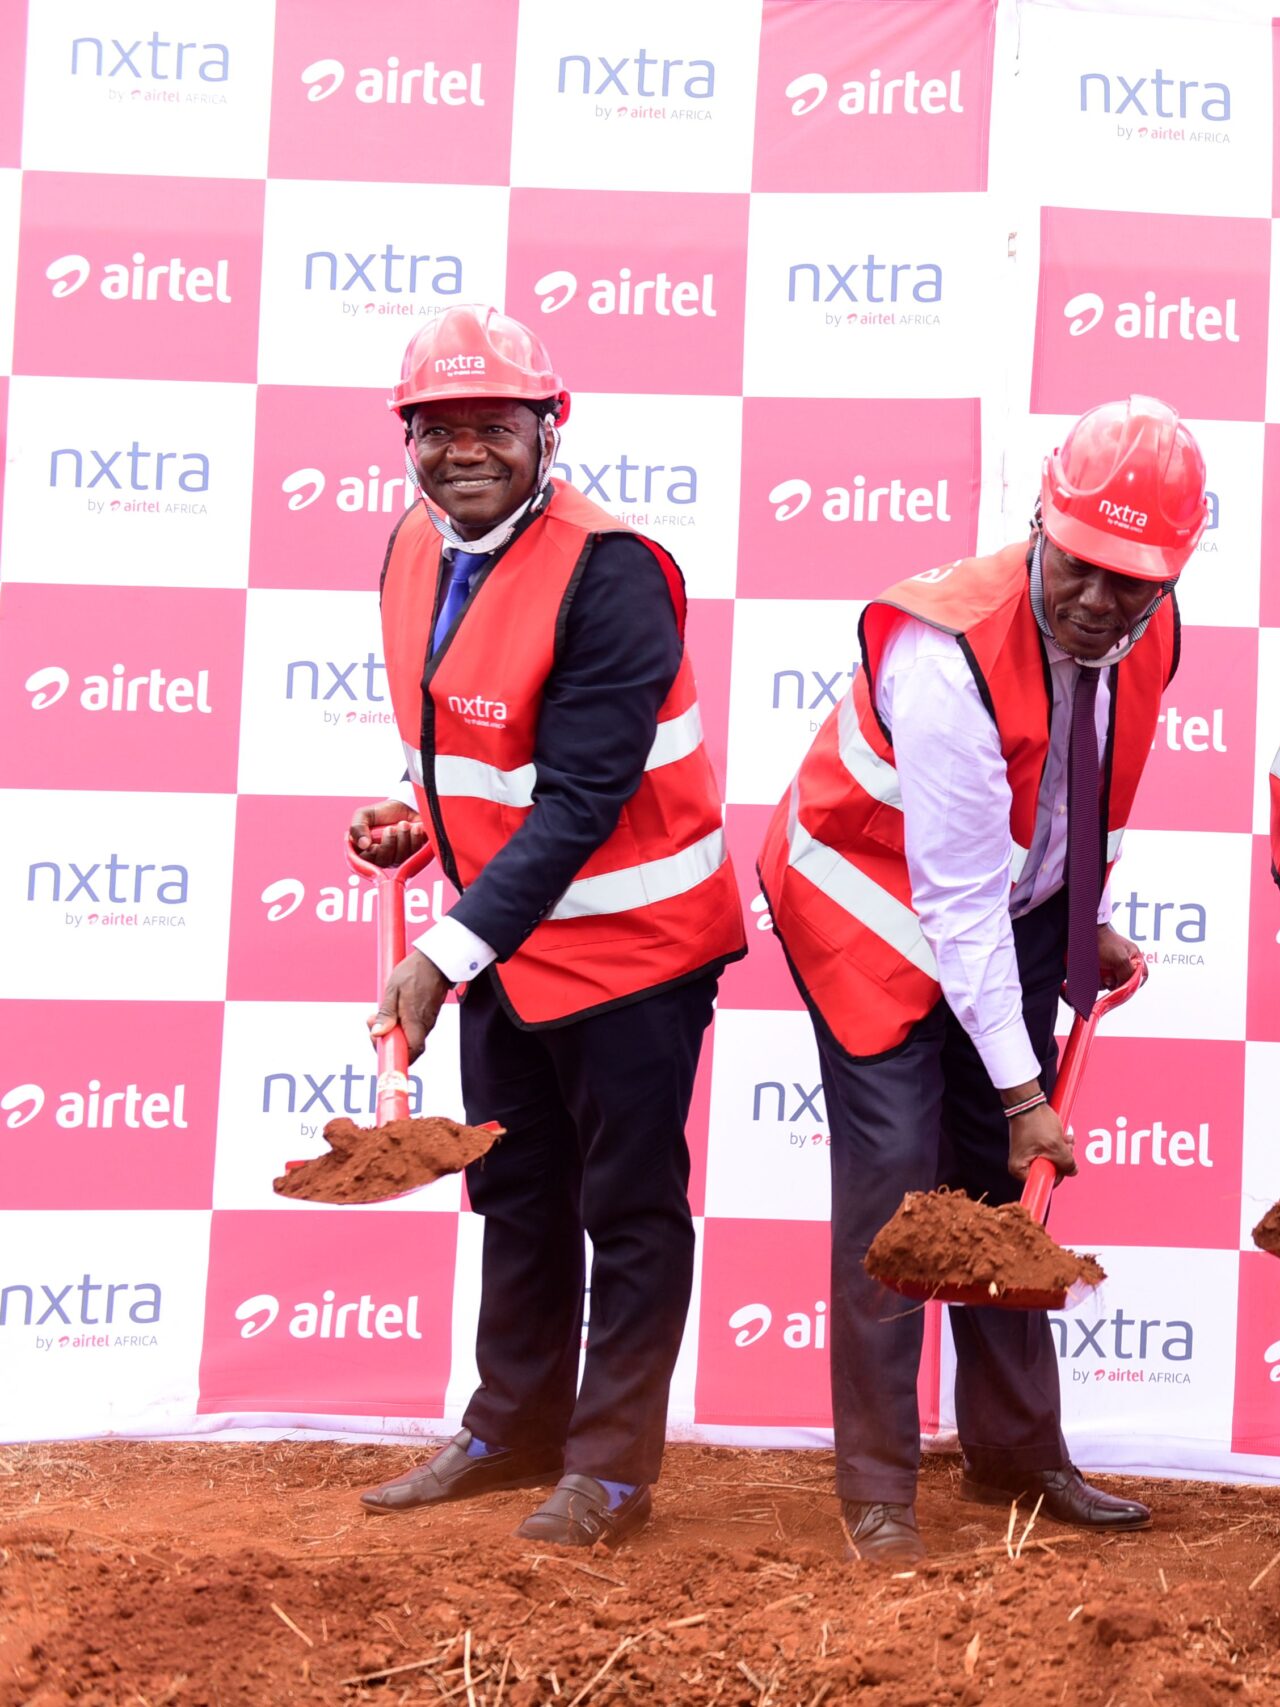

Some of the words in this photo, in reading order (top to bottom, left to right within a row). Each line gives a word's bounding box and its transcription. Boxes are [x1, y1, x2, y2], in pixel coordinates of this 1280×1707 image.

[72, 32, 228, 81] nxtra
[559, 49, 714, 98] nxtra
[356, 57, 484, 106] airtel
[839, 69, 963, 114] airtel
[1081, 69, 1230, 121] nxtra
[596, 104, 612, 120] by
[630, 106, 666, 119] airtel
[670, 110, 712, 120] AFRICA
[1117, 125, 1133, 140] by
[1151, 127, 1185, 140] airtel
[1190, 132, 1230, 143] AFRICA
[101, 253, 231, 303] airtel
[305, 245, 462, 294] nxtra
[588, 268, 716, 316] airtel
[789, 255, 942, 302] nxtra
[343, 302, 359, 317] by
[378, 302, 413, 315] airtel
[826, 312, 841, 327] by
[860, 311, 895, 325] airtel
[900, 315, 940, 325] AFRICA
[1115, 291, 1239, 342] airtel
[434, 354, 485, 373] nxtra
[50, 442, 209, 492] nxtra
[88, 499, 104, 514] by
[124, 499, 160, 513] airtel
[165, 504, 207, 515] AFRICA
[654, 515, 696, 527] AFRICA
[823, 475, 950, 522] airtel
[1098, 499, 1148, 527] nxtra
[80, 664, 211, 713] airtel
[286, 653, 386, 701] nxt
[324, 711, 340, 726] by
[448, 695, 507, 720] nxtra
[28, 854, 188, 904] nxtra
[316, 875, 444, 923] airel
[65, 912, 83, 928] by
[101, 912, 138, 926] airtel
[143, 916, 186, 927] AFRICA
[1162, 954, 1205, 966] AFRICA
[56, 1080, 187, 1128] airtel
[300, 1123, 318, 1139] by
[790, 1132, 807, 1149] by
[1086, 1117, 1213, 1167] airtel
[0, 1274, 161, 1325] nxtra
[289, 1290, 421, 1339] airtel
[36, 1336, 53, 1352] by
[73, 1334, 110, 1348] airtel
[114, 1335, 158, 1347] AFRICA
[1072, 1368, 1090, 1384] by
[1108, 1368, 1144, 1382] airtel
[1149, 1372, 1191, 1384] AFRICA
